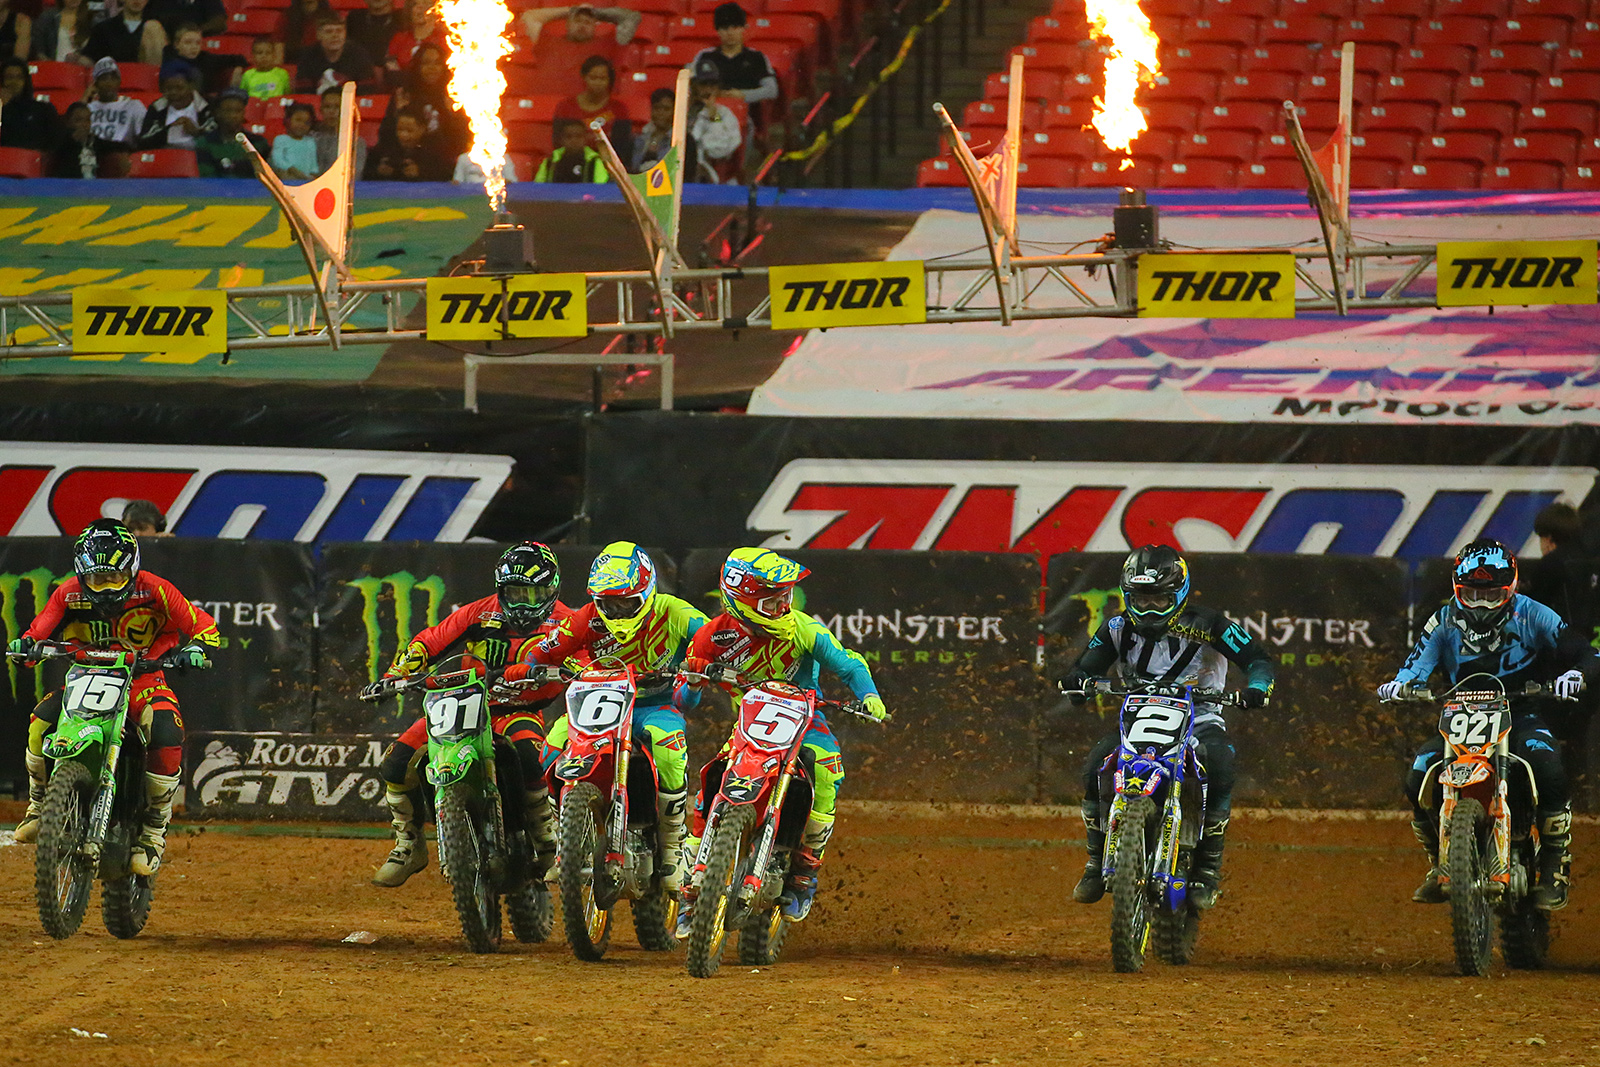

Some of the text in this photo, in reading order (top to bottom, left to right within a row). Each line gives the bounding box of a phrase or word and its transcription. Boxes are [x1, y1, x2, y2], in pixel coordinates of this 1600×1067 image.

[1151, 270, 1282, 302] THOR
[1451, 256, 1584, 289] THOR
[440, 290, 573, 324] THOR
[783, 276, 910, 313] THOR
[86, 305, 214, 337] THOR
[725, 567, 746, 587] 5
[813, 609, 1008, 644] MONSTER
[1224, 610, 1375, 648] NSTER
[865, 650, 978, 664] NERGY
[66, 675, 125, 711] 15
[577, 689, 626, 726] 6
[430, 693, 482, 737] 91
[747, 703, 804, 744] 5
[1127, 705, 1185, 745] 2
[1448, 711, 1502, 744] 921
[248, 738, 357, 768] ROCKY
[99, 788, 113, 841] DUNLOP
[753, 824, 774, 878] WISECO
